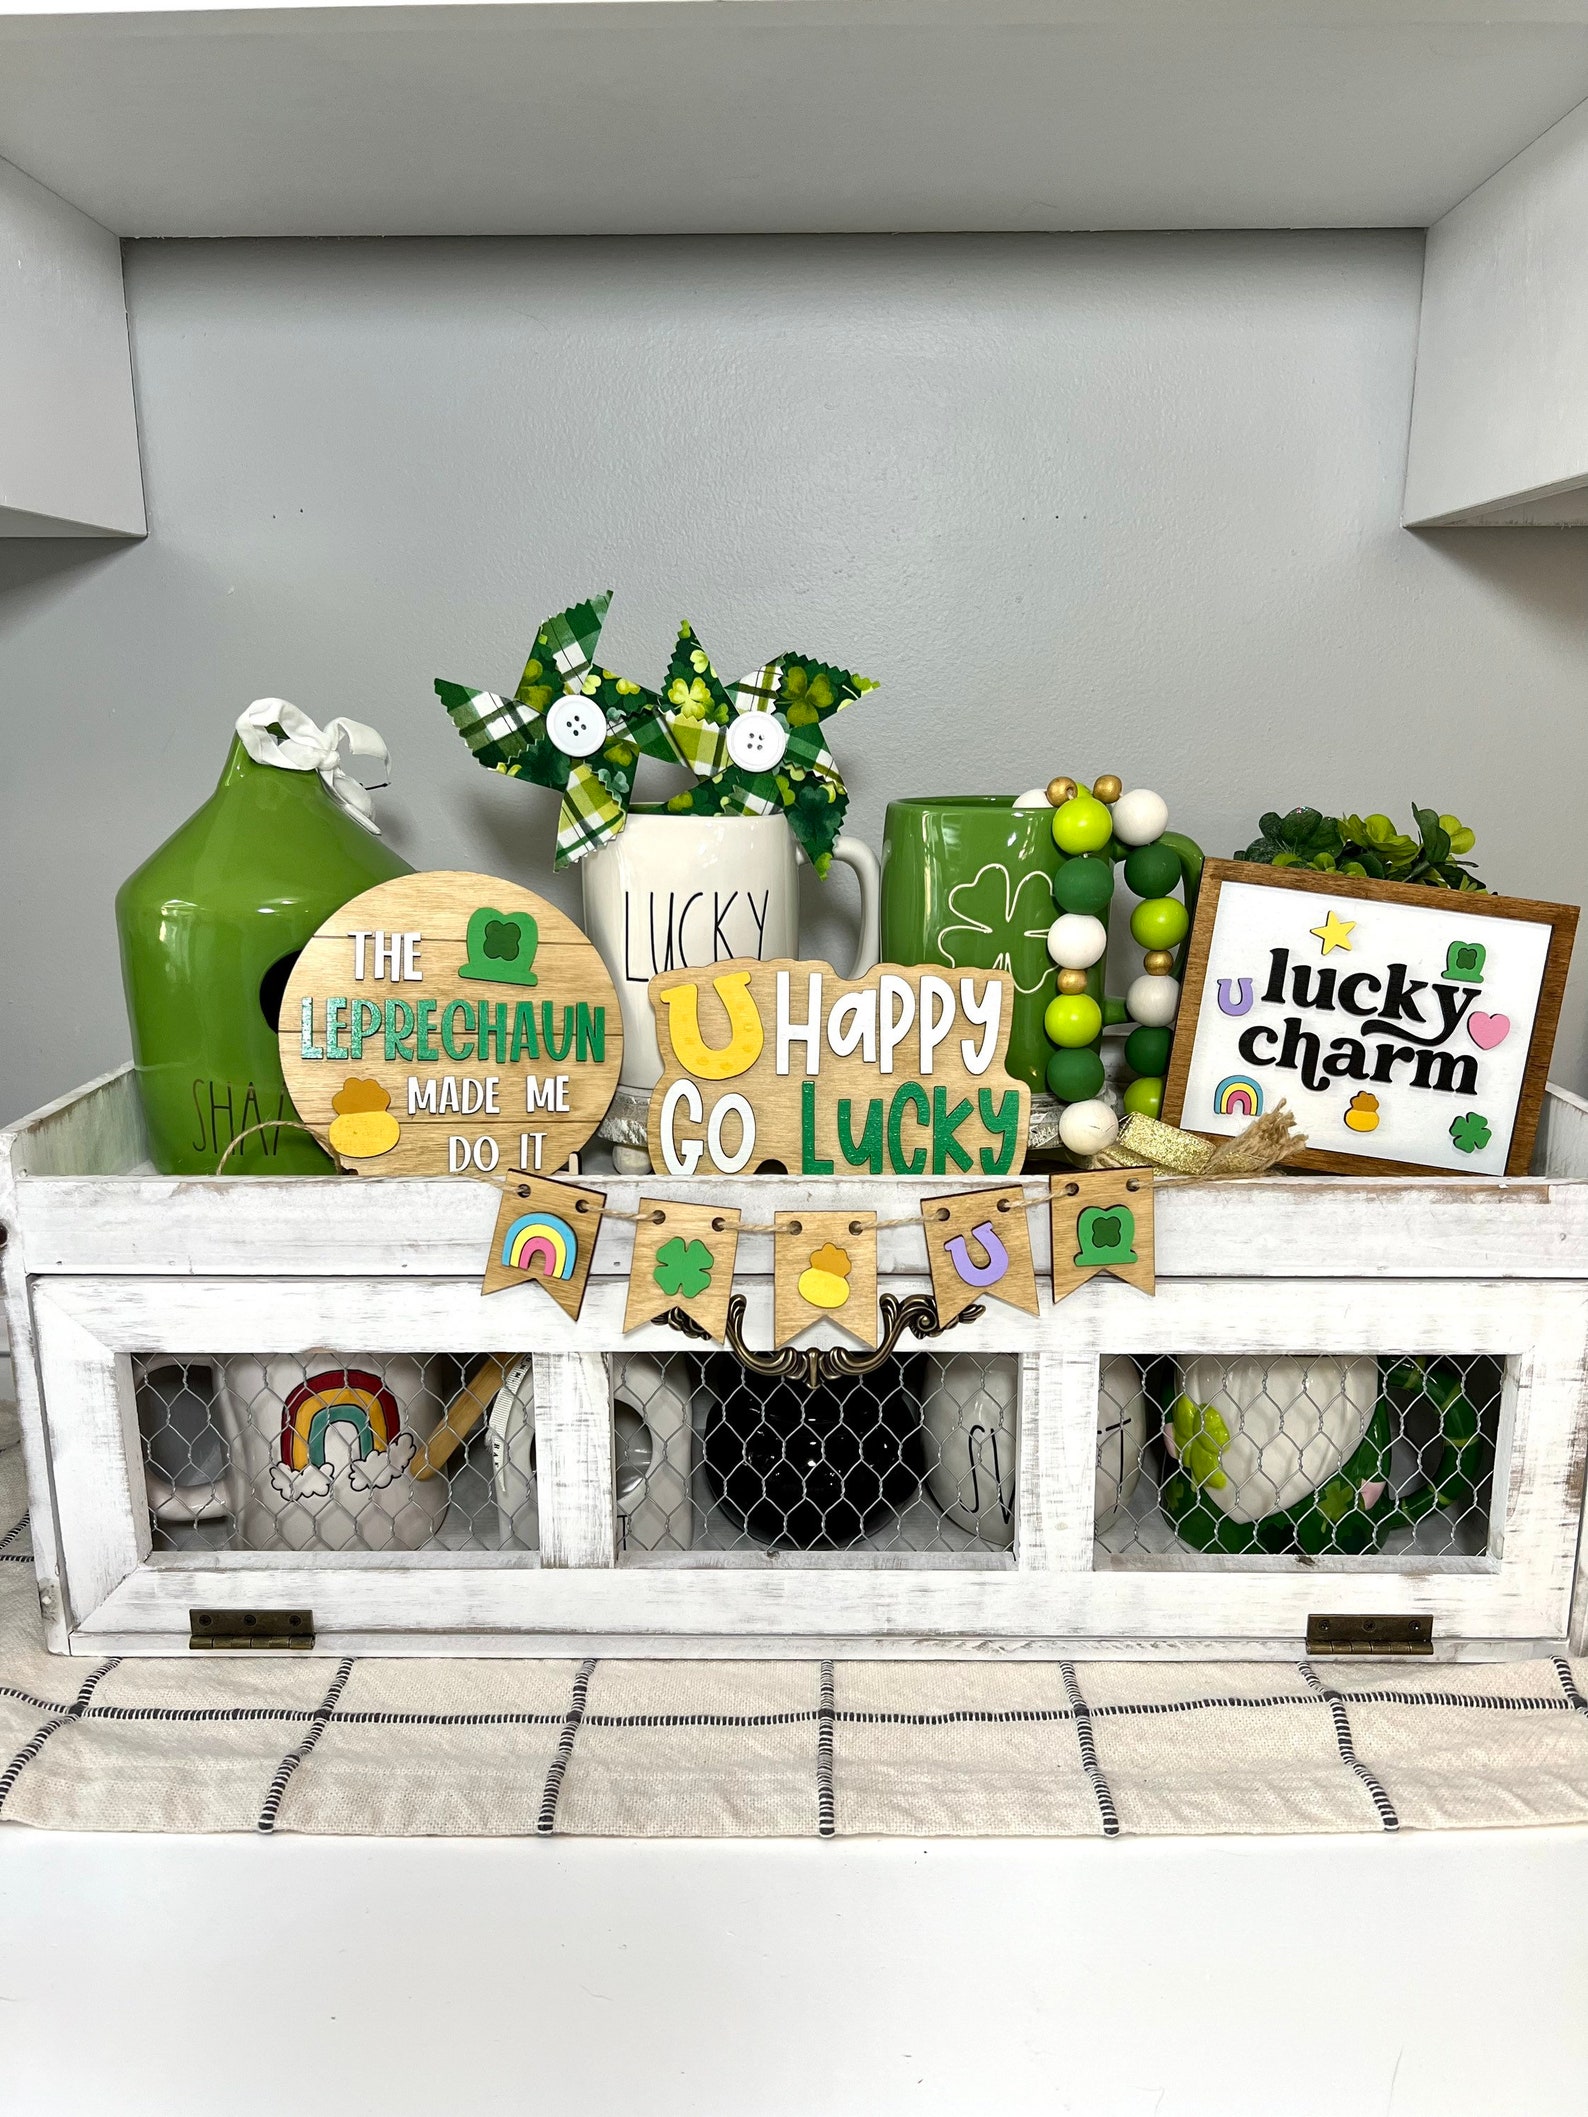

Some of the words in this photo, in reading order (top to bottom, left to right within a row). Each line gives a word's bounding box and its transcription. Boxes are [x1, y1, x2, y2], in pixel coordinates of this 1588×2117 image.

[347, 931, 424, 981] THE
[624, 889, 770, 982] LUCKY
[299, 996, 606, 1063] LEPRECHAUN
[1260, 947, 1482, 1047] lucky
[1237, 1017, 1479, 1096] charm
[406, 1075, 501, 1115] MADE
[526, 1075, 571, 1113] ME
[660, 1078, 757, 1175] GO
[448, 1135, 500, 1174] DO
[519, 1132, 548, 1171] IT
